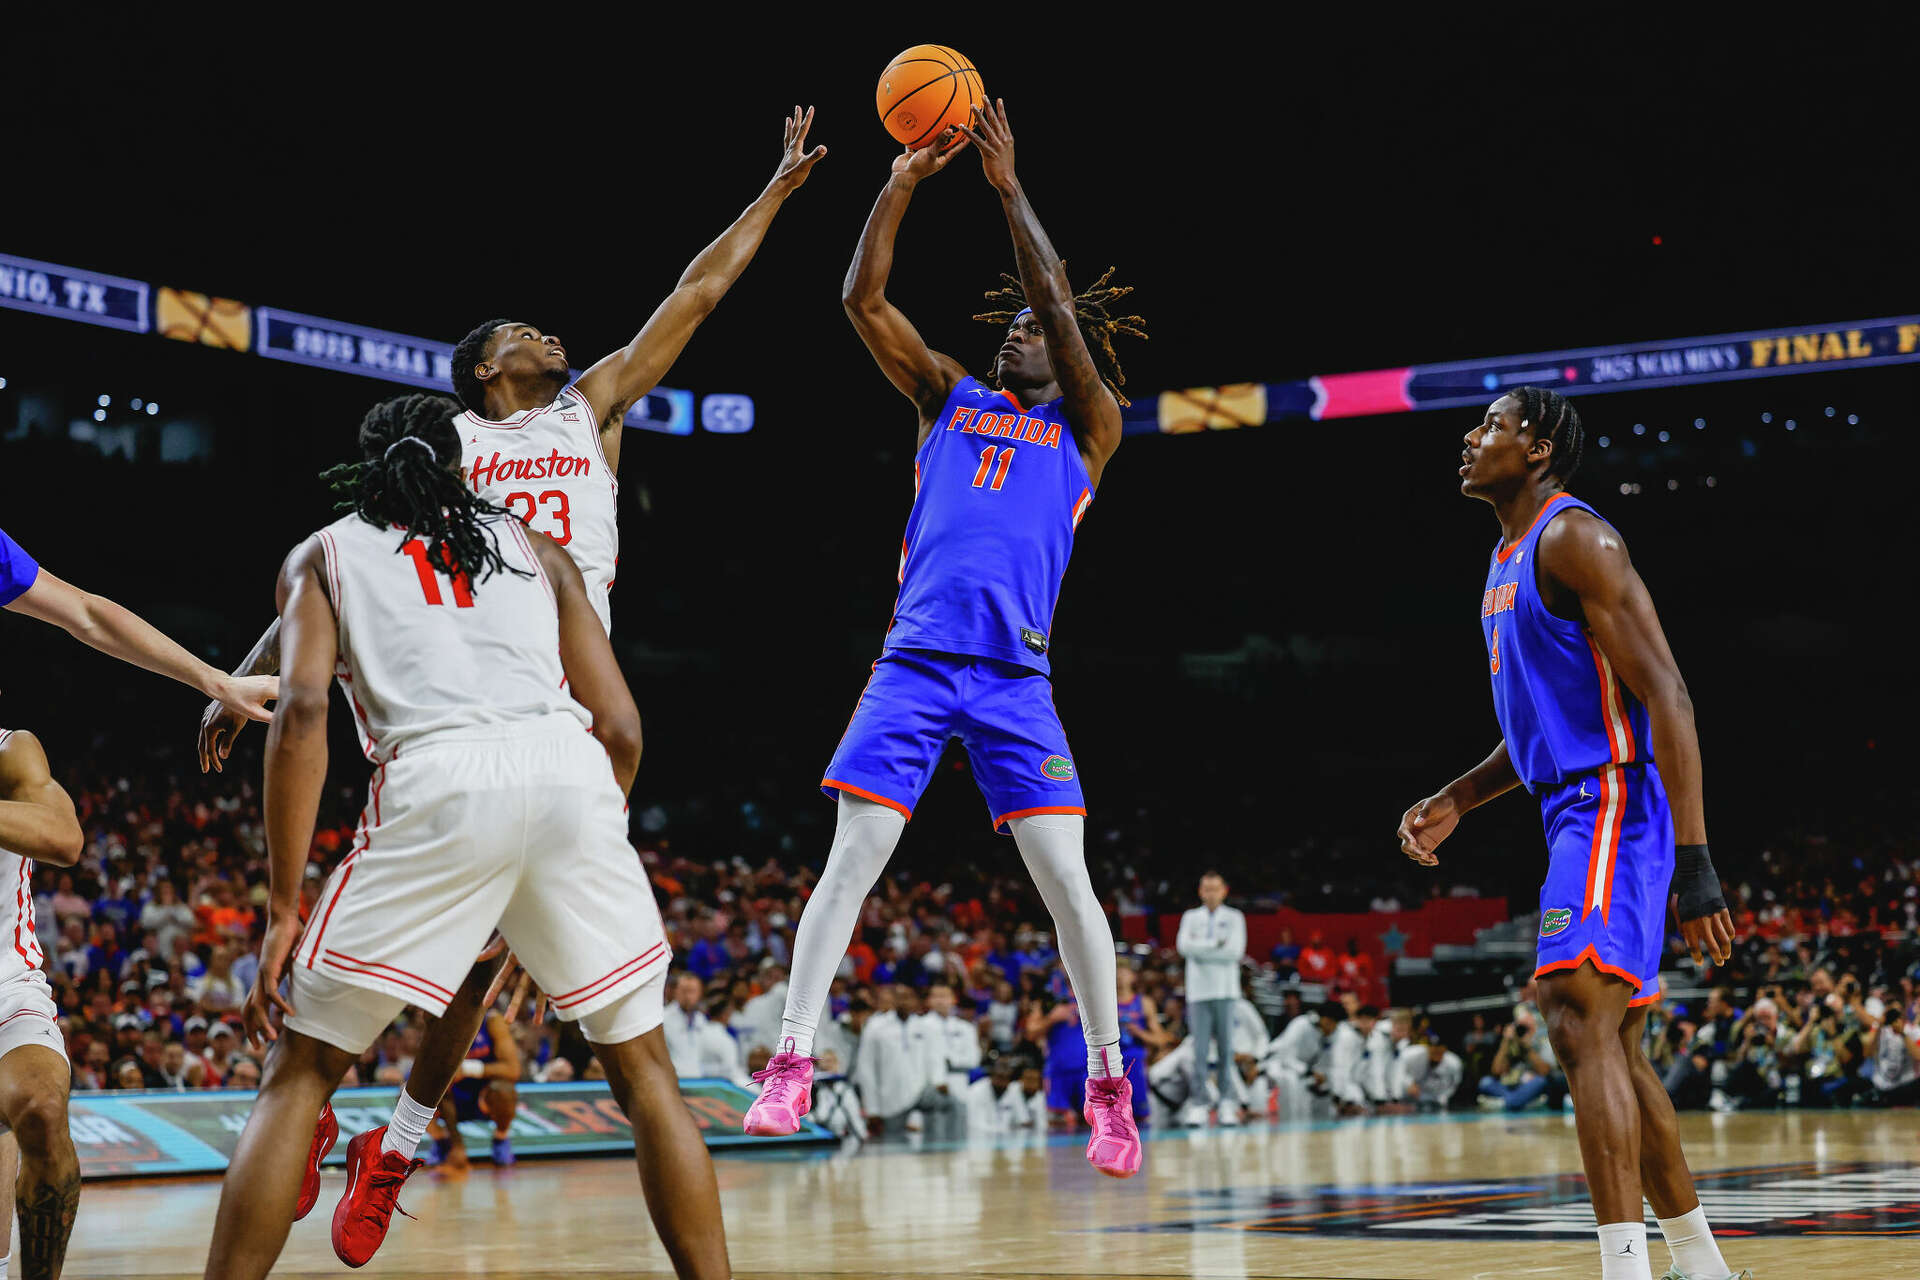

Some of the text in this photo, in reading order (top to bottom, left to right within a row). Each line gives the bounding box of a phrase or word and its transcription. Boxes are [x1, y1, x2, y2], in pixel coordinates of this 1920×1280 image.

[63, 280, 107, 314] TX
[1751, 330, 1872, 368] FINAL
[946, 406, 1063, 449] FLORIDA
[469, 447, 591, 493] Houston
[971, 445, 1016, 491] 11
[505, 489, 573, 546] 23
